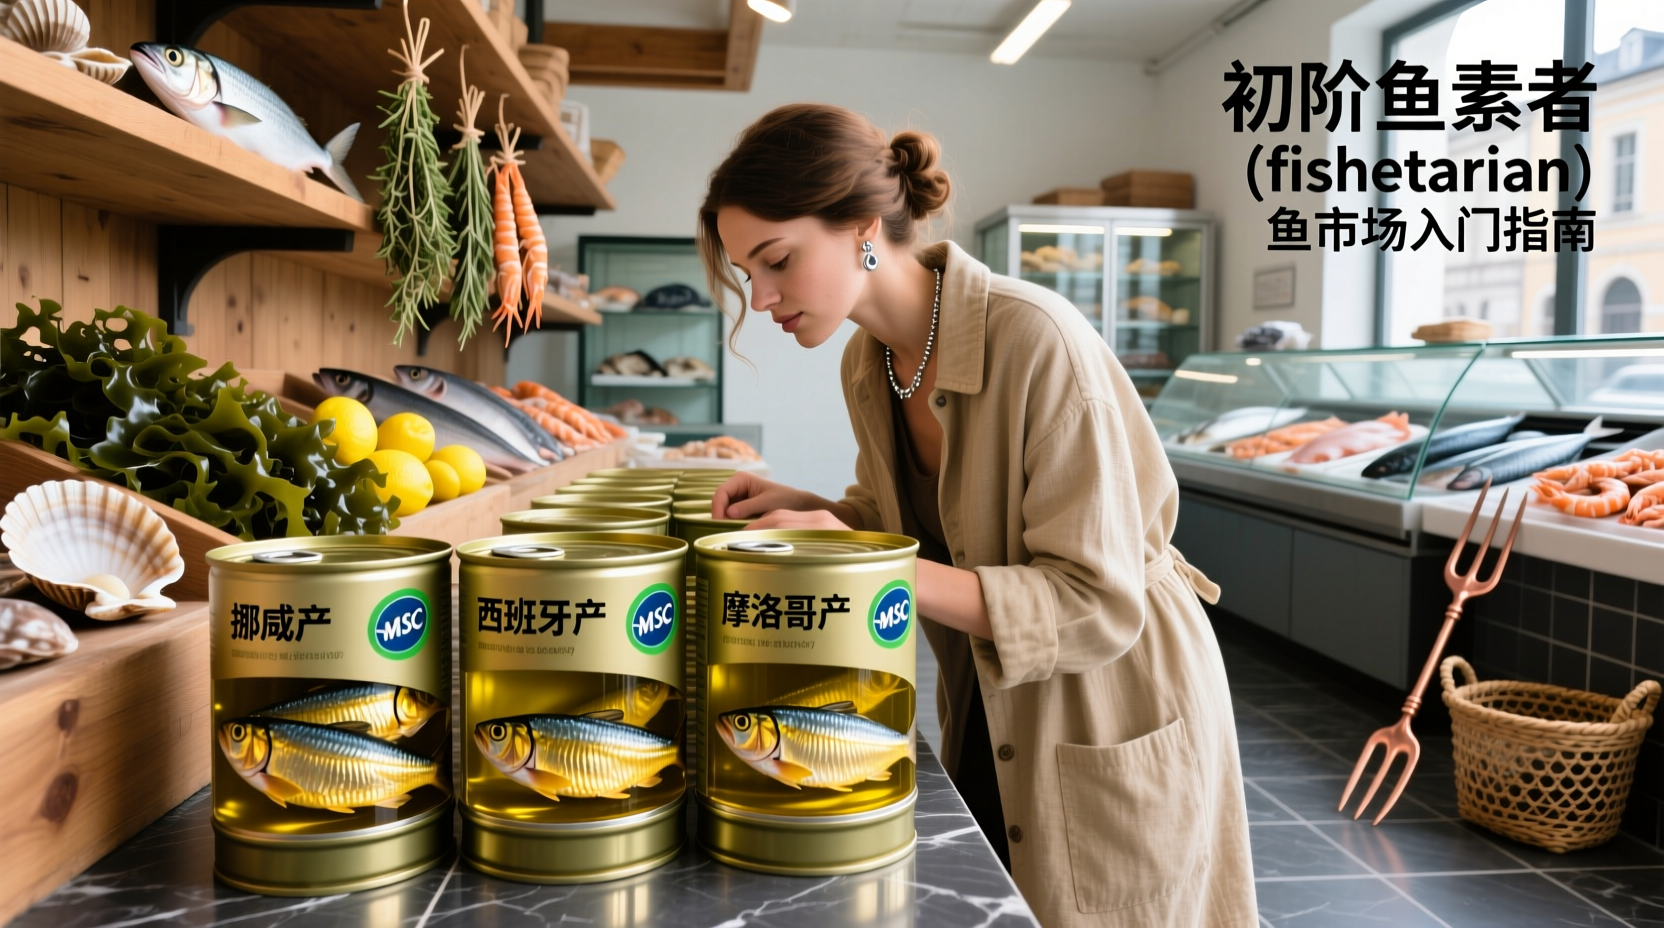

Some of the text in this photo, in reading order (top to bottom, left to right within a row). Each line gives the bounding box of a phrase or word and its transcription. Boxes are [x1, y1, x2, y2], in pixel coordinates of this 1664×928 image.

[383, 607, 424, 642] MSC
[477, 597, 607, 637] 西班牙产
[638, 602, 673, 637] MSC
[721, 590, 851, 631] 摩洛哥产
[879, 599, 910, 630] MSC
